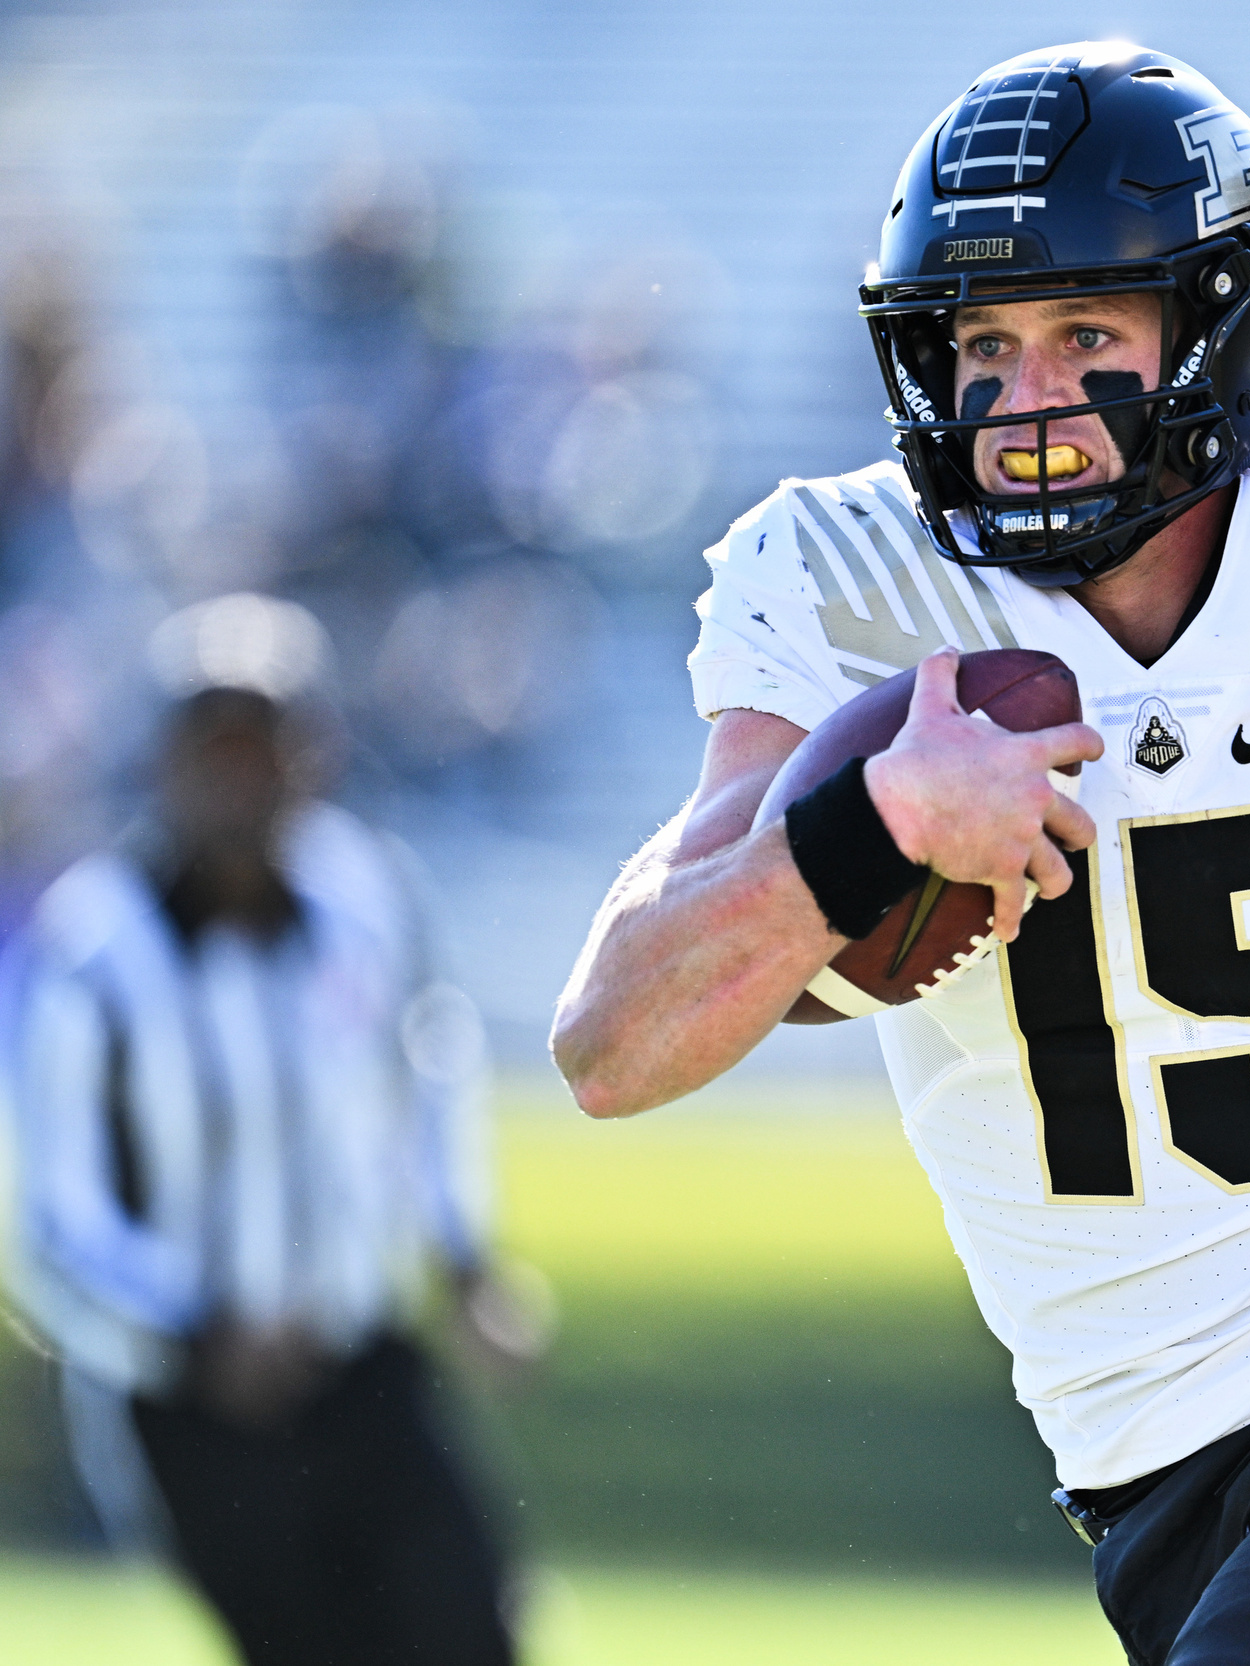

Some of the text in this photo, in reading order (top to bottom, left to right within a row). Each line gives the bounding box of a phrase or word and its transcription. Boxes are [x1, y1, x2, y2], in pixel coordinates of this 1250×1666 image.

[944, 237, 1013, 262] PURDUE
[1002, 513, 1069, 534] BOILER UP
[1138, 745, 1181, 766] PURDUE
